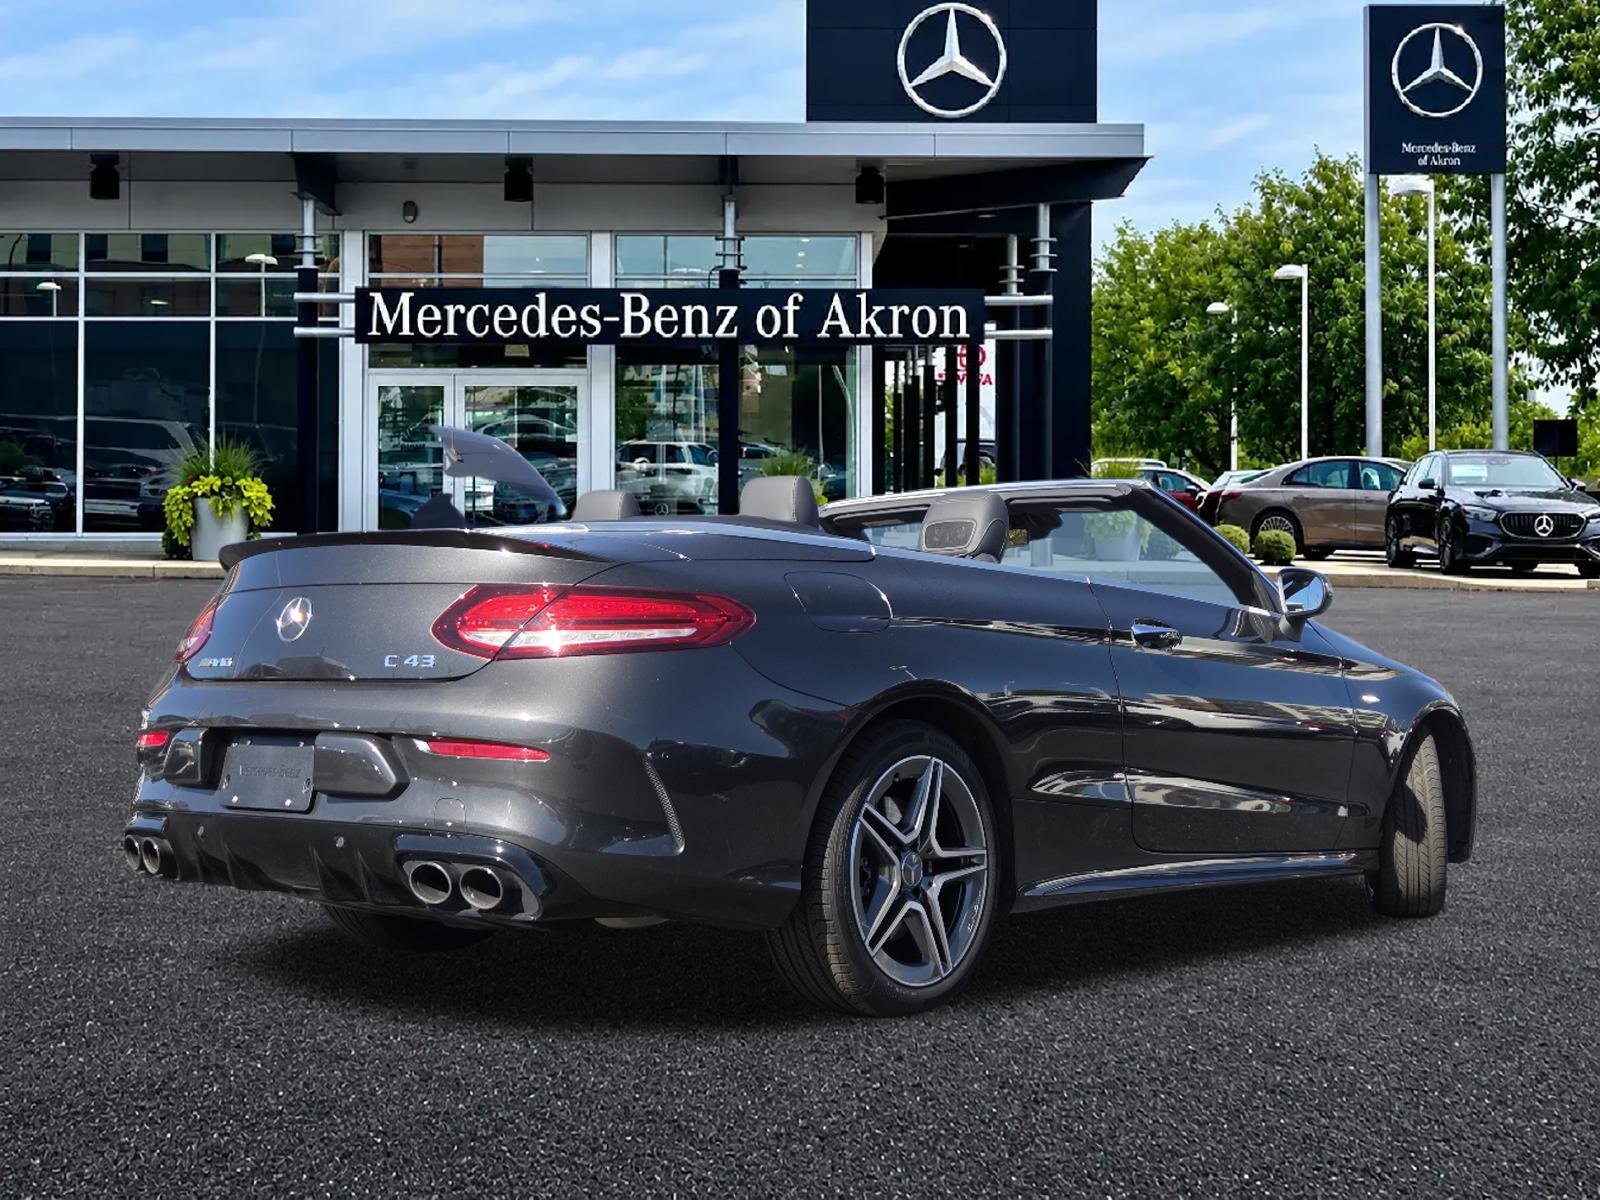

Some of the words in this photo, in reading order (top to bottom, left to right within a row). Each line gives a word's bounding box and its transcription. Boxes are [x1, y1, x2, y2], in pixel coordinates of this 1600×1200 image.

[1401, 141, 1476, 153] Mercedes-Benz
[1418, 154, 1429, 166] of
[1430, 154, 1461, 166] Akron
[367, 291, 738, 338] Mercedes-Benz
[755, 292, 804, 338] of
[816, 291, 971, 338] Akron
[384, 654, 398, 668] C
[403, 654, 435, 668] 43
